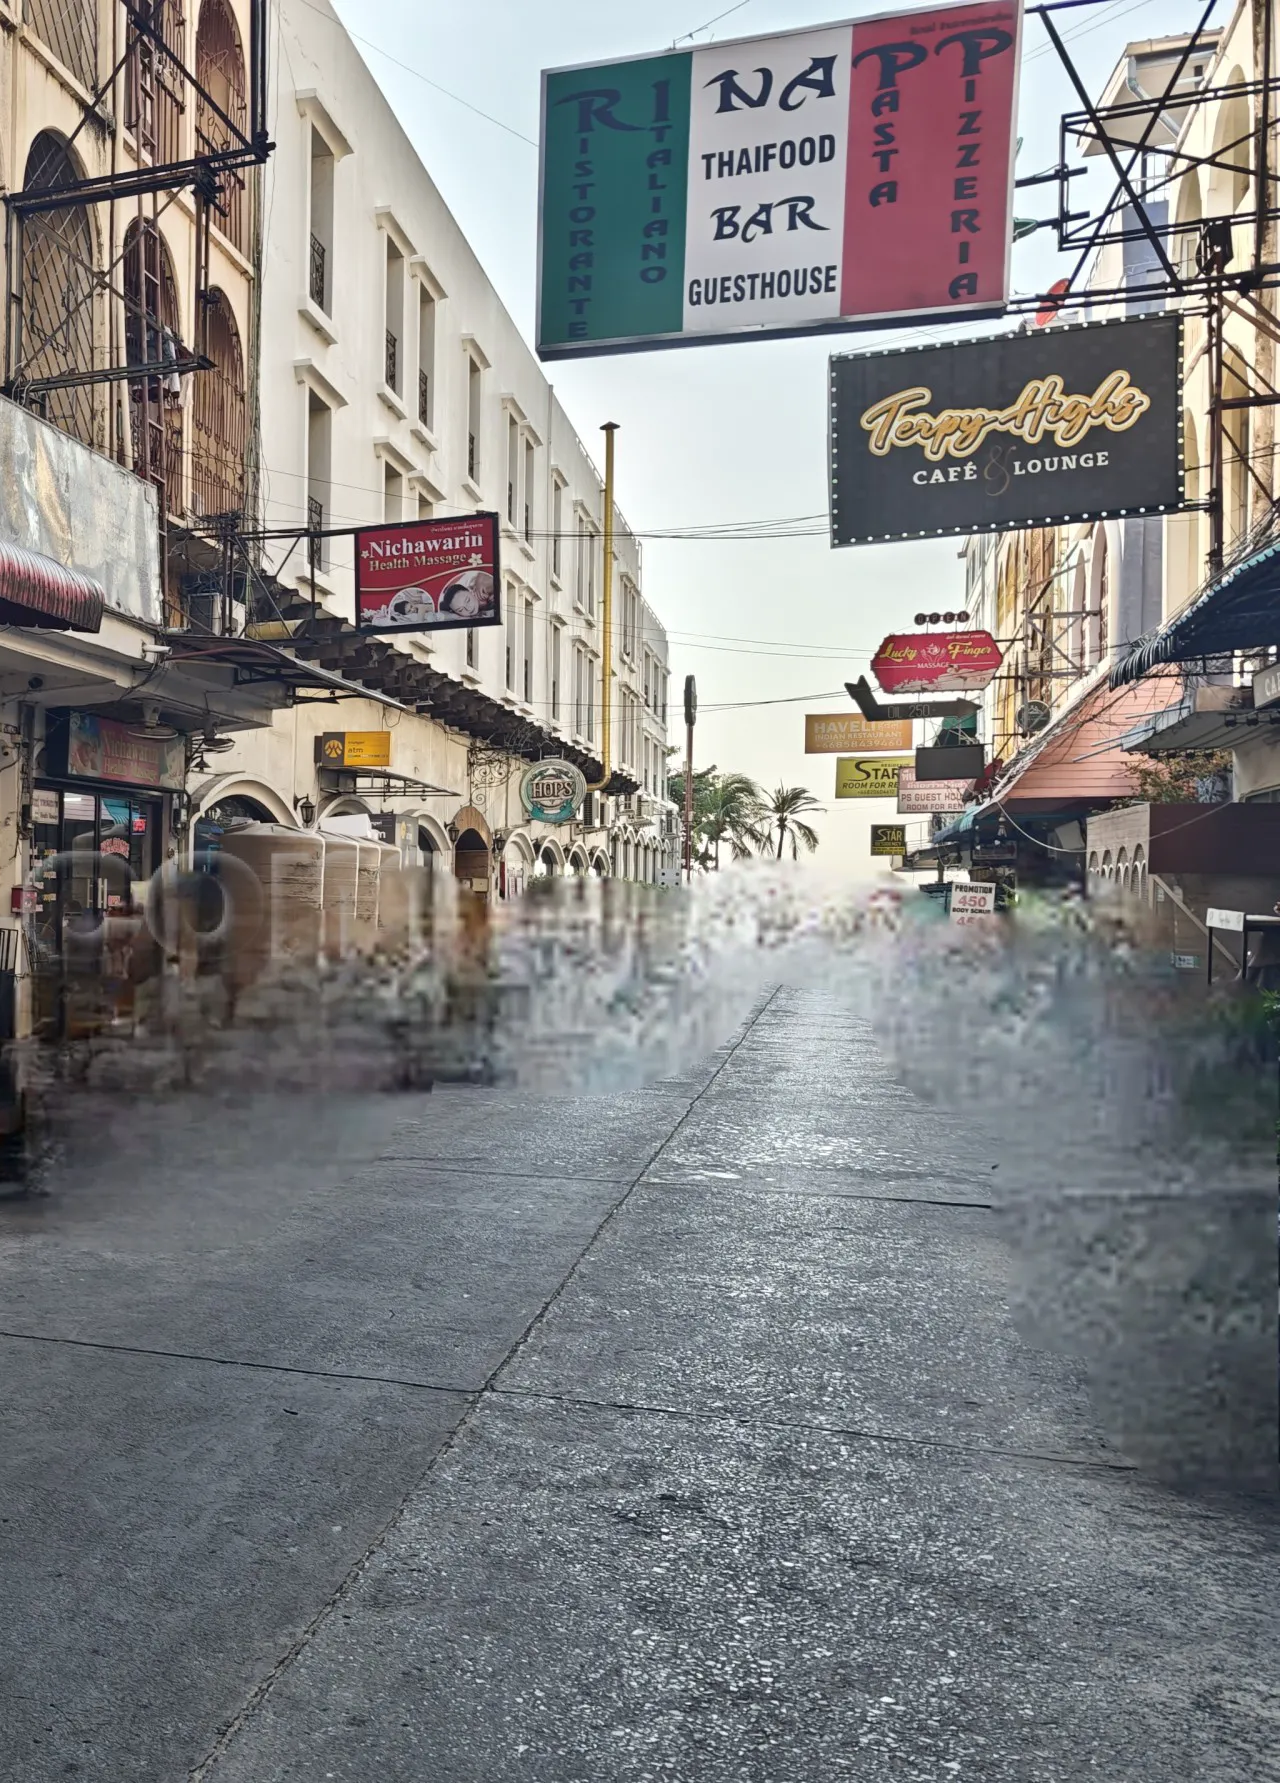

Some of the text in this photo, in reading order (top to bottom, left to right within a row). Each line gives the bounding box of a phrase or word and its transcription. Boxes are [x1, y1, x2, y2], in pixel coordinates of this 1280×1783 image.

[703, 54, 838, 114] NA
[852, 40, 929, 208] PASTA
[701, 134, 836, 180] THAIFOOD
[933, 26, 1013, 300] PIZZERIA
[639, 79, 673, 284] ITALIANO
[554, 88, 647, 338] RISTORANTE
[710, 196, 831, 243] BAR
[688, 265, 838, 306] GUESTHOUSE
[860, 369, 1150, 461] Terpy Highs
[912, 461, 978, 485] CAFÉ
[1013, 451, 1110, 476] LOUNGE
[369, 531, 484, 559] Nichawarin
[369, 552, 467, 571] Health Massage
[916, 611, 969, 624] OPEN
[879, 640, 993, 663] Lucky Finger
[916, 661, 952, 669] MASSAGE
[887, 705, 902, 719] OIL
[814, 731, 902, 742] INDIAN RESTAURANT
[532, 781, 573, 798] HOPS
[842, 782, 868, 790] ROOM
[901, 793, 912, 802] PS
[914, 792, 942, 802] GUEST
[906, 803, 929, 811] ROOM
[874, 828, 903, 842] STAR
[954, 884, 993, 894] PROMOTION
[958, 895, 987, 908] 450
